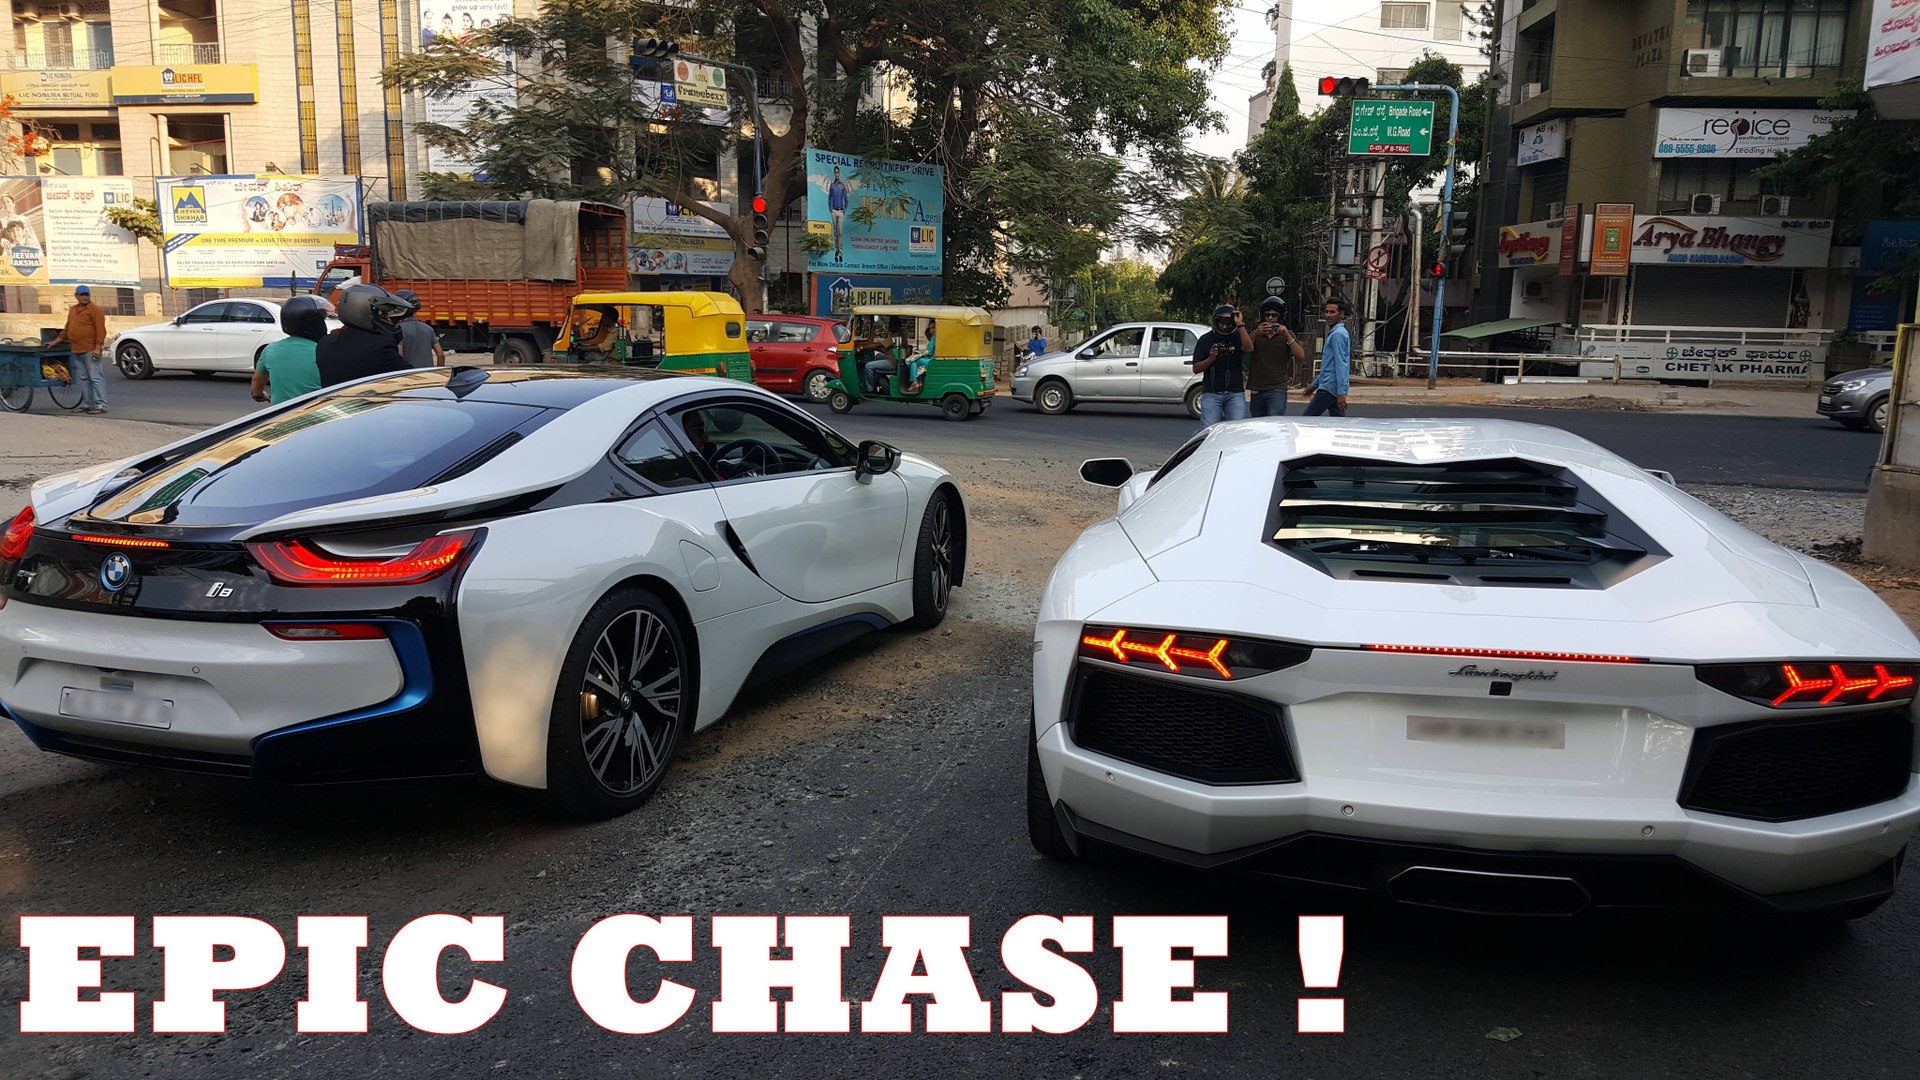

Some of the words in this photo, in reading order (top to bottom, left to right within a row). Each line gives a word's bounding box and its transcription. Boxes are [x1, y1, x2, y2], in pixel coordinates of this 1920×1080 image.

[451, 4, 468, 12] grow
[469, 4, 478, 12] up
[494, 2, 509, 10] fast!
[174, 72, 187, 83] LIC
[187, 73, 203, 83] HFL
[677, 84, 725, 102] frameboxx
[1388, 105, 1408, 119] Brigade
[1408, 105, 1422, 117] Road
[1389, 145, 1410, 153] B-TRAC
[1735, 147, 1765, 155] Leading
[815, 153, 851, 167] SPECIAL
[853, 159, 910, 174] RECRUITMENT
[912, 165, 935, 176] DRIVE
[116, 193, 130, 204] LIC
[921, 228, 935, 243] LIC
[1633, 225, 1696, 254] Arya
[877, 262, 888, 270] Office
[891, 263, 916, 272] Development
[851, 290, 868, 305] LIC
[869, 290, 888, 305] HFL
[1664, 361, 1734, 374] CHETAK
